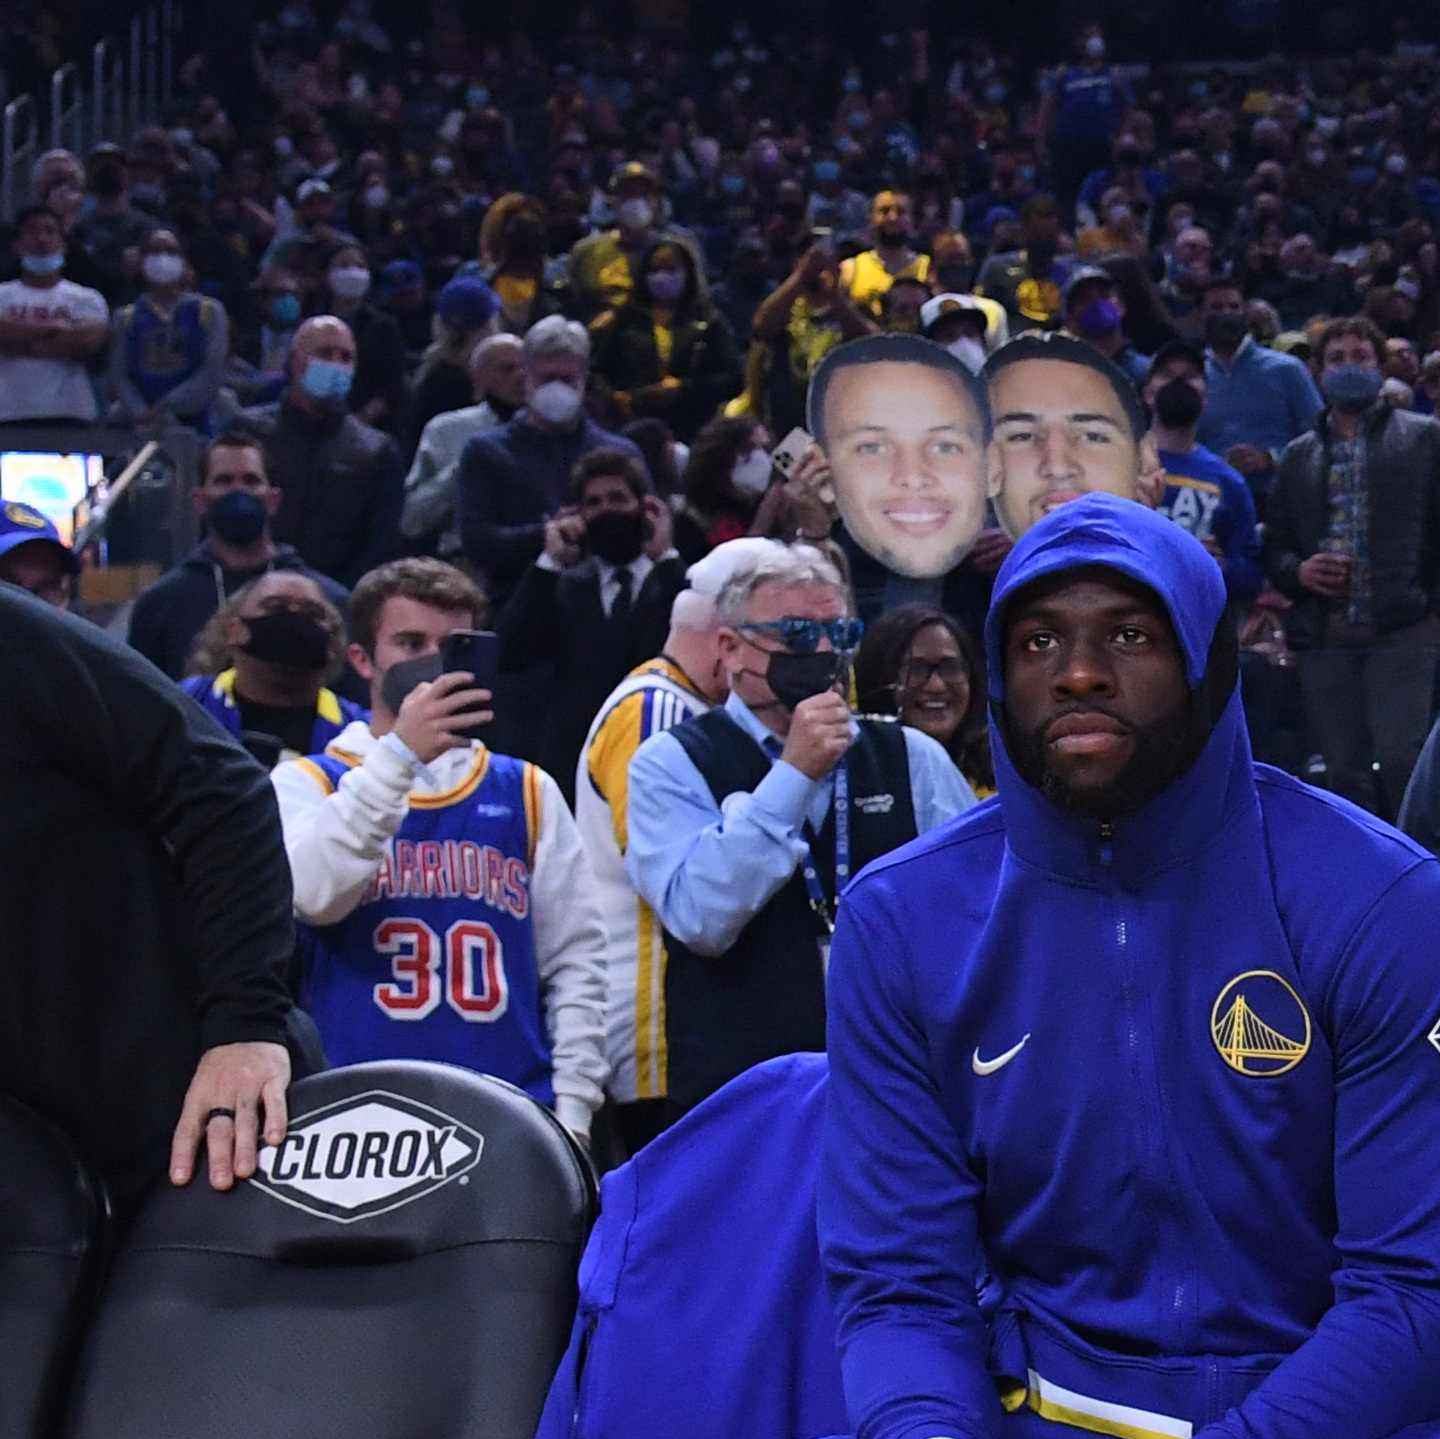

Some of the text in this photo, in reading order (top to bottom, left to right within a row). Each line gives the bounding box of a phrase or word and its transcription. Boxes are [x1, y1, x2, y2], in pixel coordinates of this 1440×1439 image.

[372, 839, 528, 920] ARRIORS
[373, 917, 508, 1022] 30
[271, 1129, 452, 1181] CLOROX
